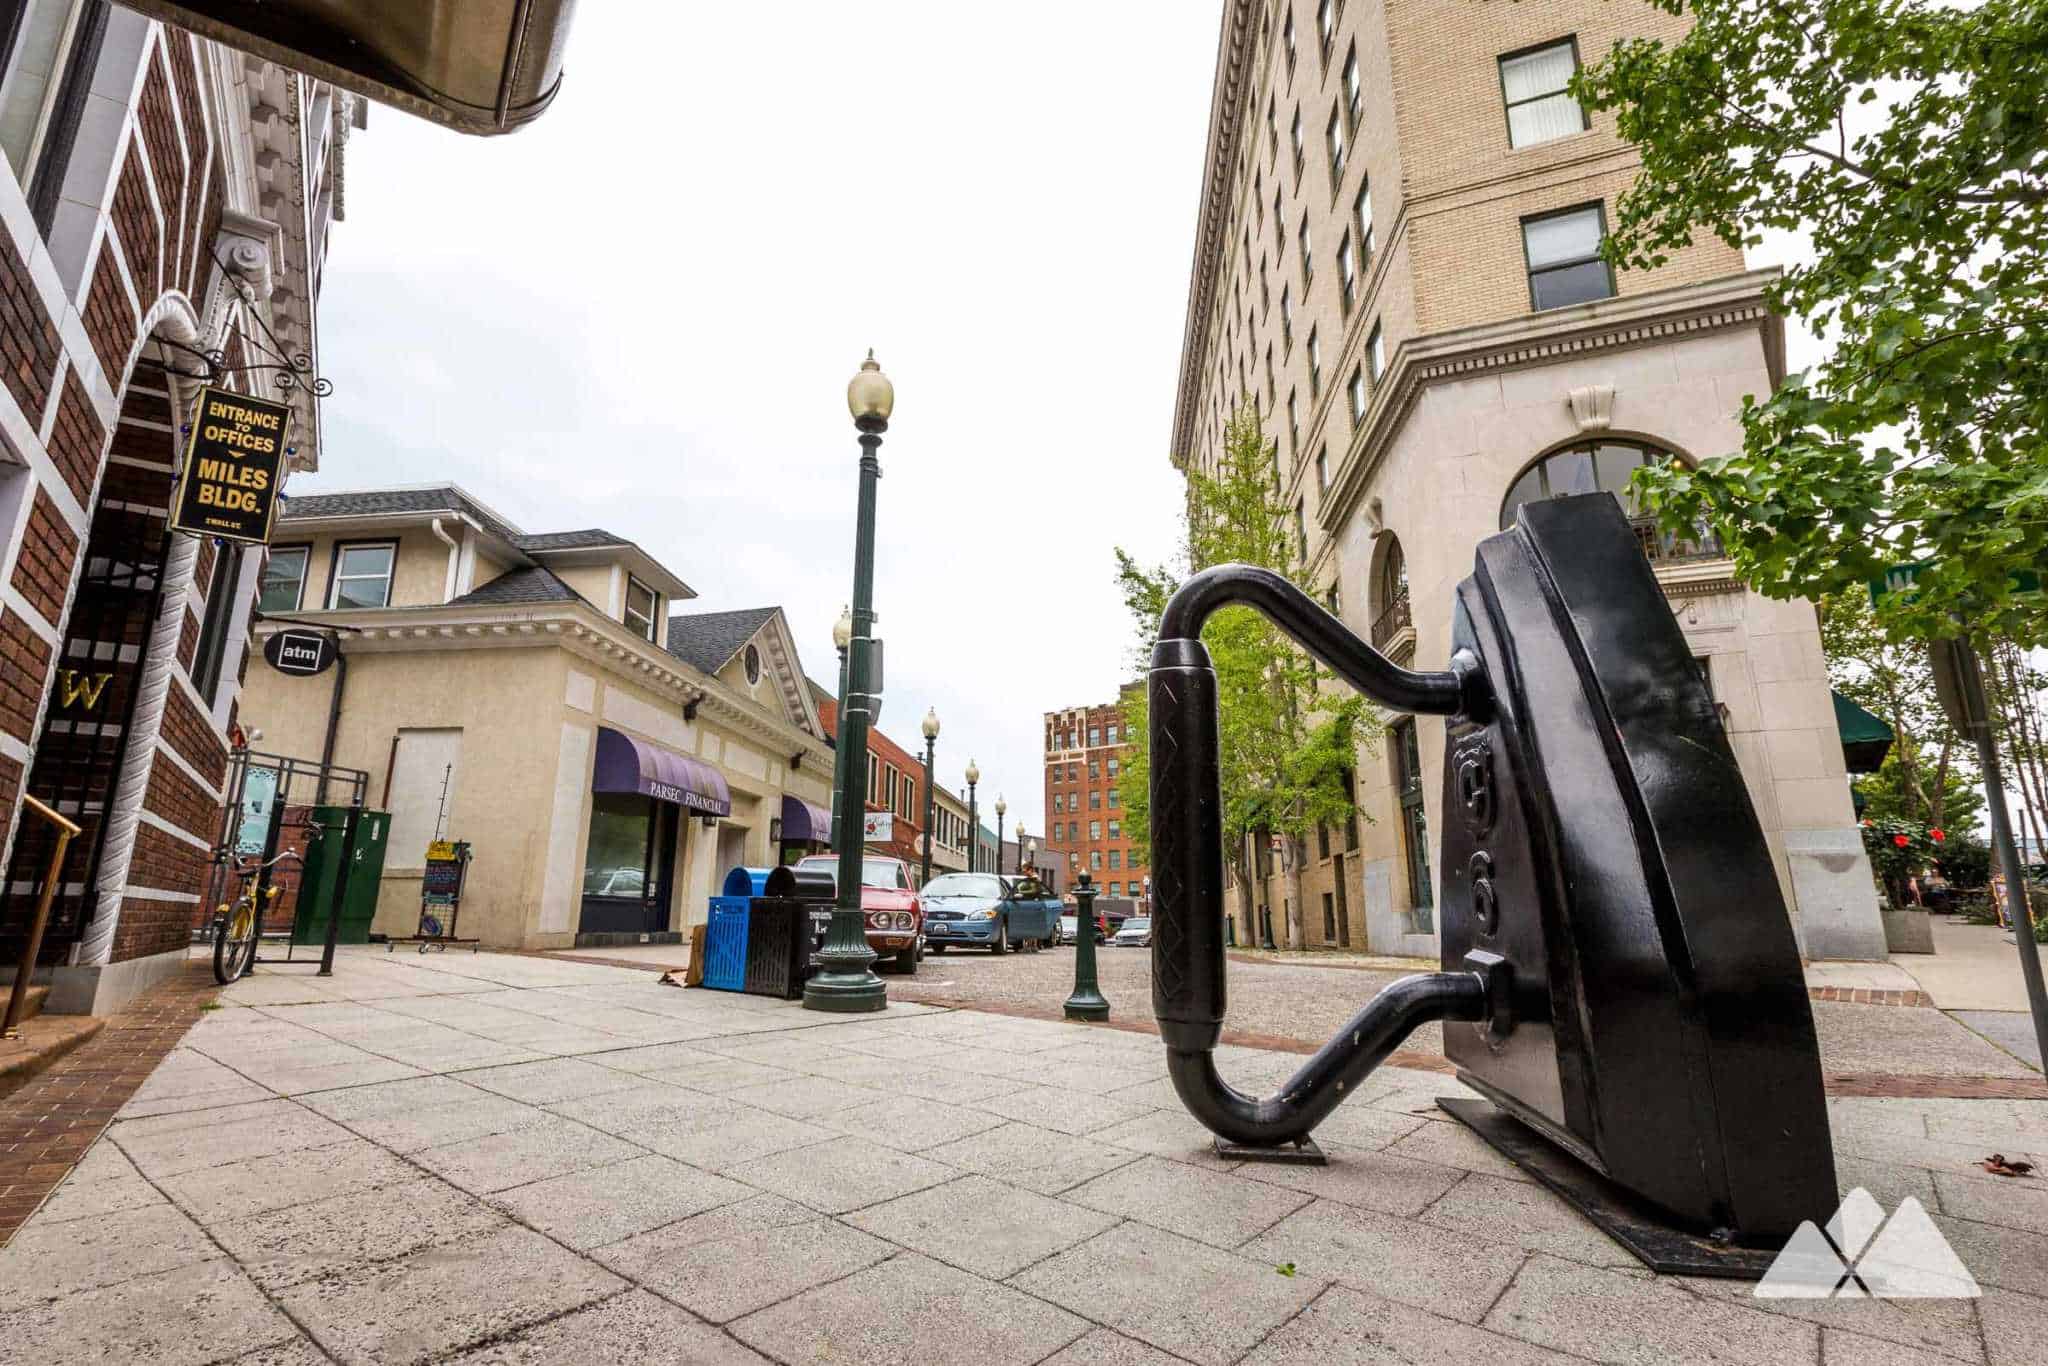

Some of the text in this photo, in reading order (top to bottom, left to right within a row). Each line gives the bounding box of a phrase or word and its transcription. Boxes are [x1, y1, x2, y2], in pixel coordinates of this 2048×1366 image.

[209, 402, 280, 430] ENTRANCE
[235, 422, 250, 433] TO
[204, 425, 275, 453] OFFICES
[198, 458, 268, 490] MILES
[198, 484, 262, 513] BLDG.
[283, 645, 317, 661] atm
[57, 668, 113, 710] W
[650, 782, 721, 813] PARSEC FINANCIAL
